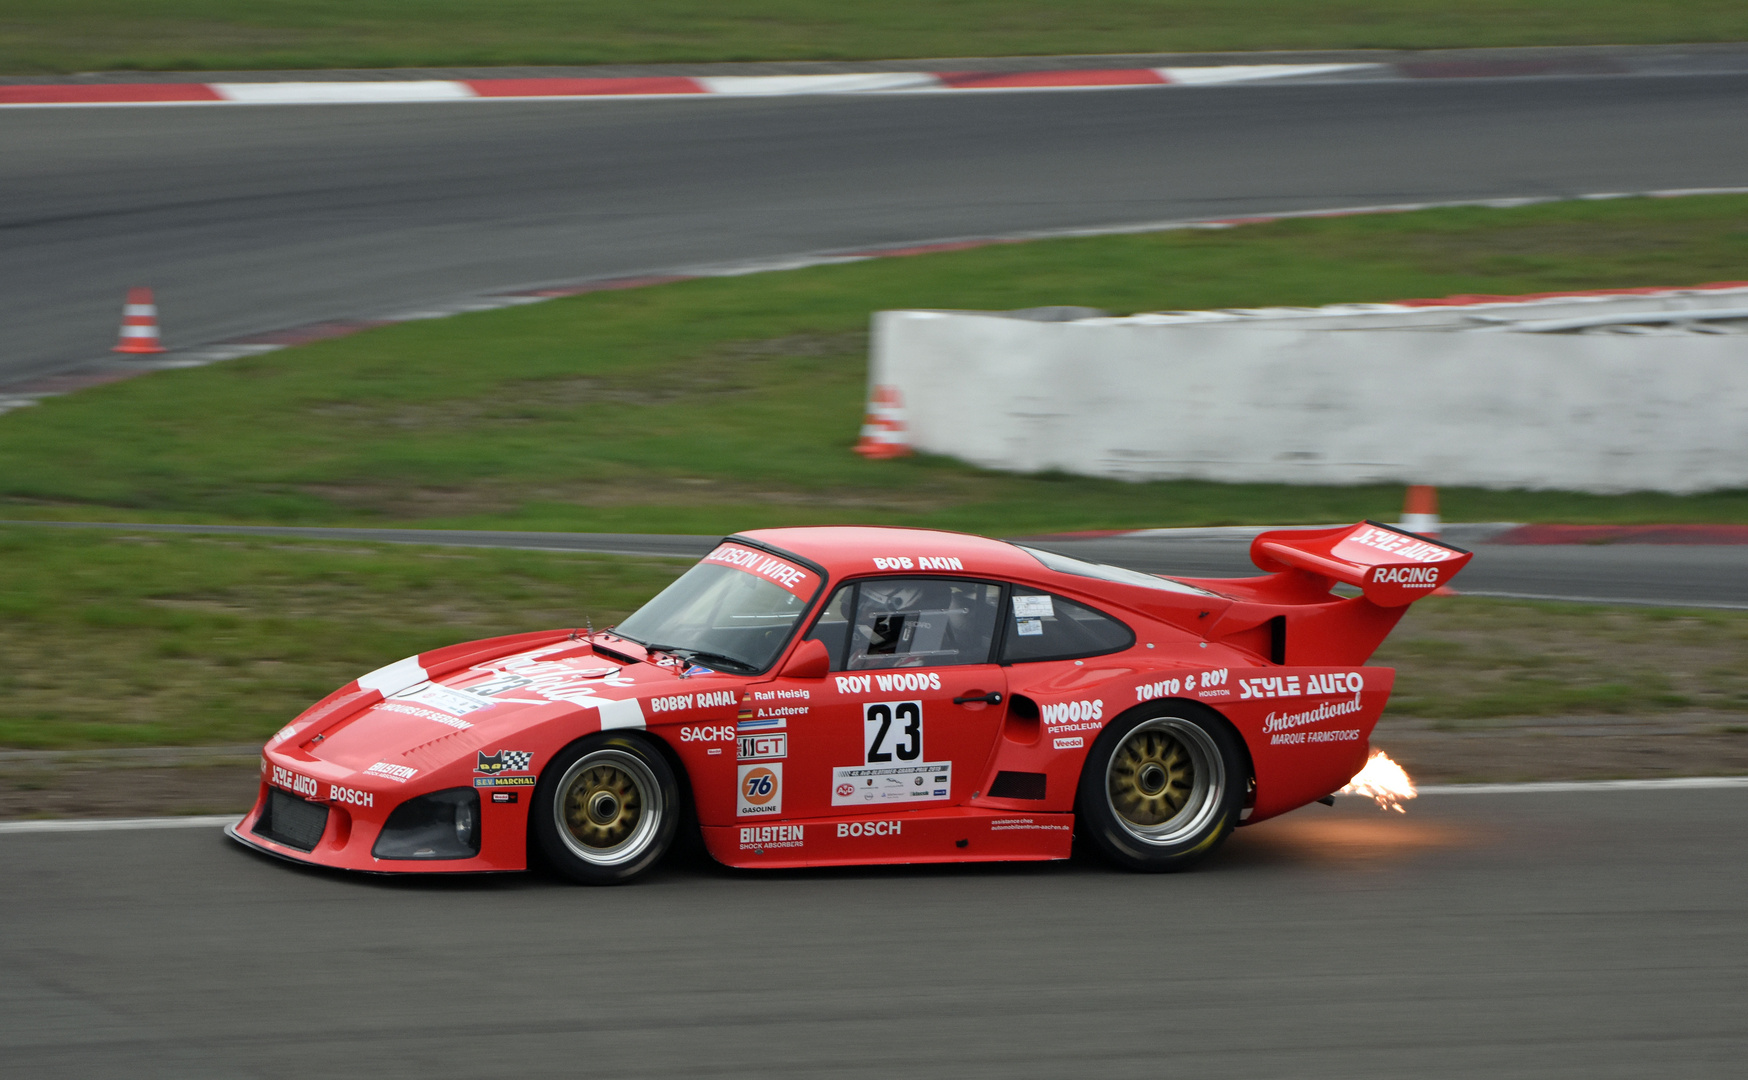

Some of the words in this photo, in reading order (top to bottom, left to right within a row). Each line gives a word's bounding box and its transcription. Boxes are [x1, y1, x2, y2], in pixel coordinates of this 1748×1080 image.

[1350, 529, 1411, 552] STYLE
[1393, 542, 1451, 563] AUTO
[873, 557, 914, 570] BOB
[918, 556, 963, 571] AKIN
[756, 558, 806, 588] WIRE
[1373, 567, 1439, 583] RACING
[464, 675, 534, 697] 23
[835, 676, 872, 694] ROY
[875, 672, 942, 692] WOODS
[1135, 678, 1180, 701] TONTO
[1184, 674, 1197, 691] &
[1201, 667, 1228, 688] ROY
[1239, 675, 1301, 699] STYLE
[1306, 672, 1364, 695] AUTO
[651, 693, 693, 713] BOBBY
[696, 690, 738, 708] RAHAL
[754, 691, 775, 700] Ralf
[776, 689, 810, 700] Heisig
[1198, 689, 1230, 698] HOUSTON
[757, 708, 768, 718] A.
[769, 706, 809, 716] Lotterer
[1042, 699, 1104, 725] WOODS
[1262, 692, 1363, 734] International
[680, 725, 735, 742] SACHS
[867, 702, 921, 763] 23
[1048, 721, 1103, 734] PETROLEUM
[755, 737, 783, 755] GT
[1055, 738, 1082, 748] Veedol
[1270, 730, 1305, 745] MARQUE
[1307, 729, 1360, 744] FARMSTOCKS
[367, 761, 419, 779] BILSTEIN
[272, 765, 293, 789] STYLE
[293, 775, 318, 797] AUTO
[747, 774, 773, 797] 76
[330, 785, 373, 808] BOSCH
[742, 806, 776, 814] GASOLINE
[740, 824, 804, 843] BILSTEIN
[837, 820, 902, 838] BOSCH
[739, 842, 763, 850] SHOCK
[764, 841, 804, 849] ABSORBERS
